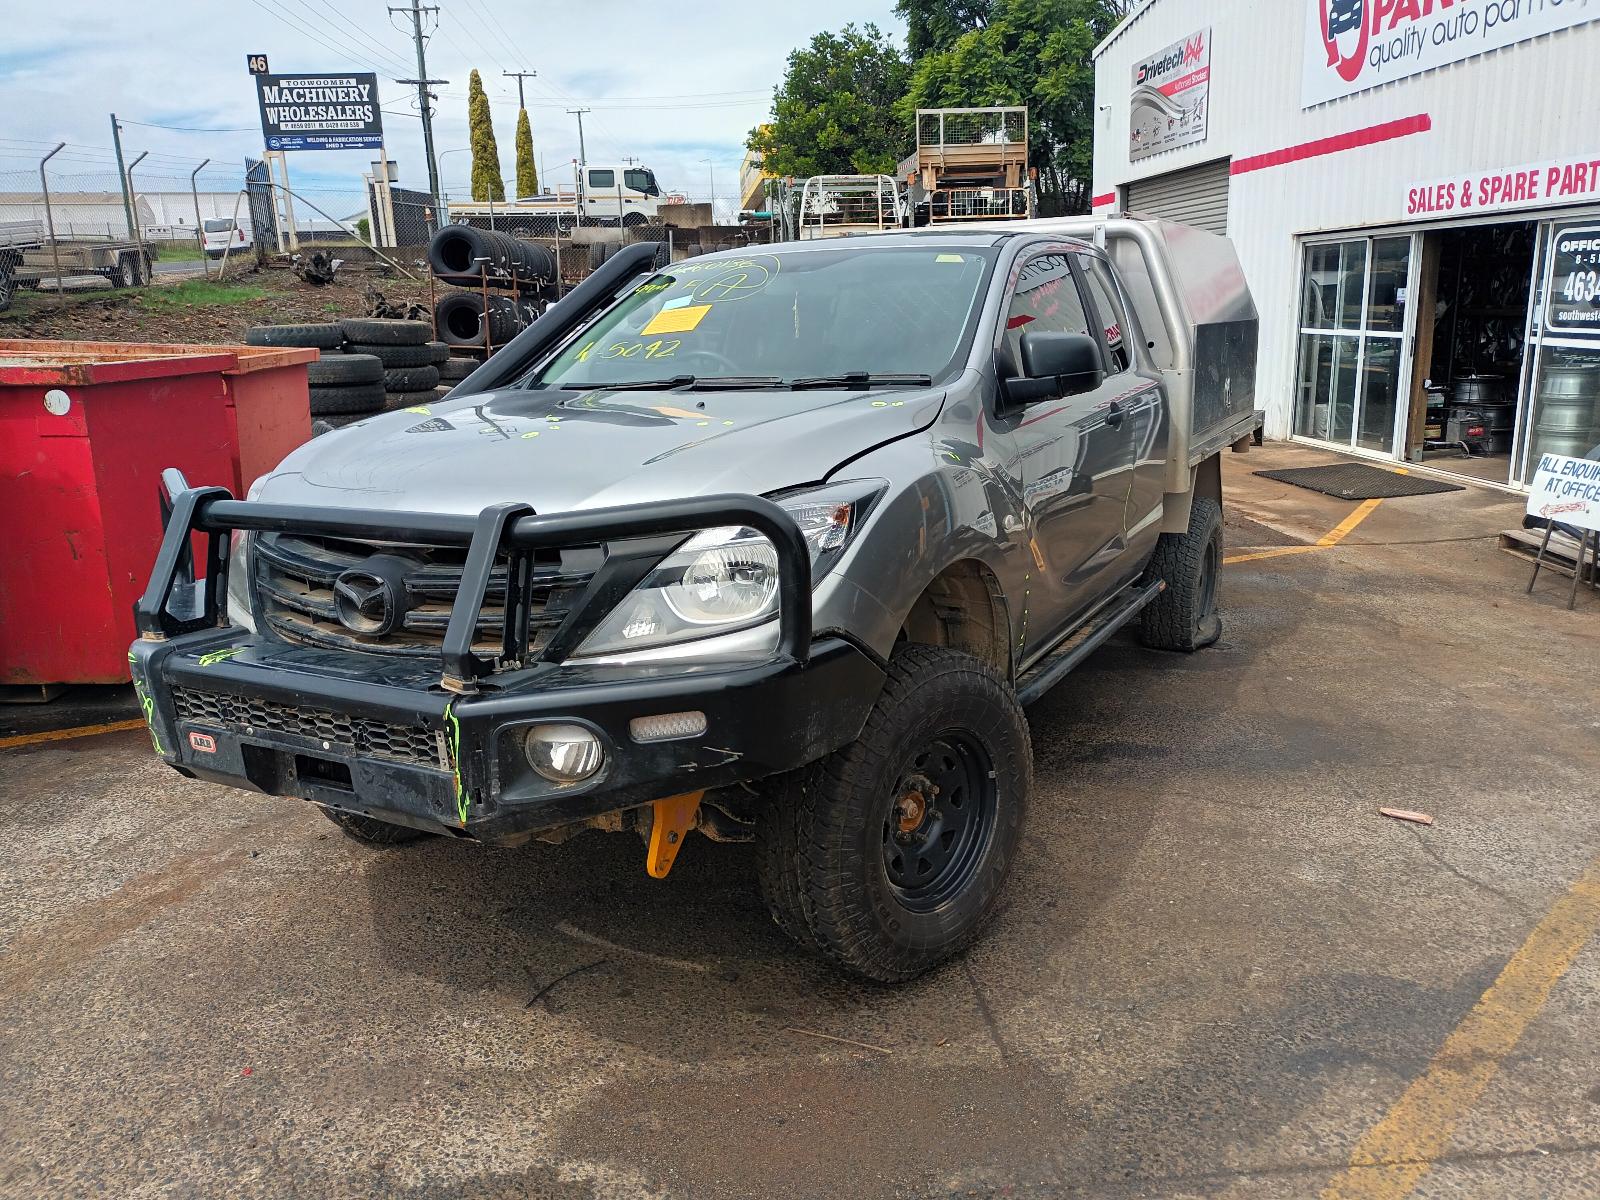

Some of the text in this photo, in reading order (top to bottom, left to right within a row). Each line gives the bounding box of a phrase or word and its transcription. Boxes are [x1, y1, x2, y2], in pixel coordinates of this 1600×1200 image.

[1369, 25, 1427, 72] quality
[1432, 7, 1478, 46] auto
[249, 56, 267, 72] 46
[1136, 46, 1184, 85] Drivetech
[263, 84, 370, 103] MACHINERY
[266, 105, 373, 124] WHOLESALERS
[1407, 160, 1600, 214] SALES & SPARE PART
[1575, 254, 1582, 264] 8
[1589, 254, 1596, 264] 5
[1537, 456, 1559, 473] ALL
[1544, 477, 1600, 502] AT OFFICE
[193, 736, 212, 749] ARB
